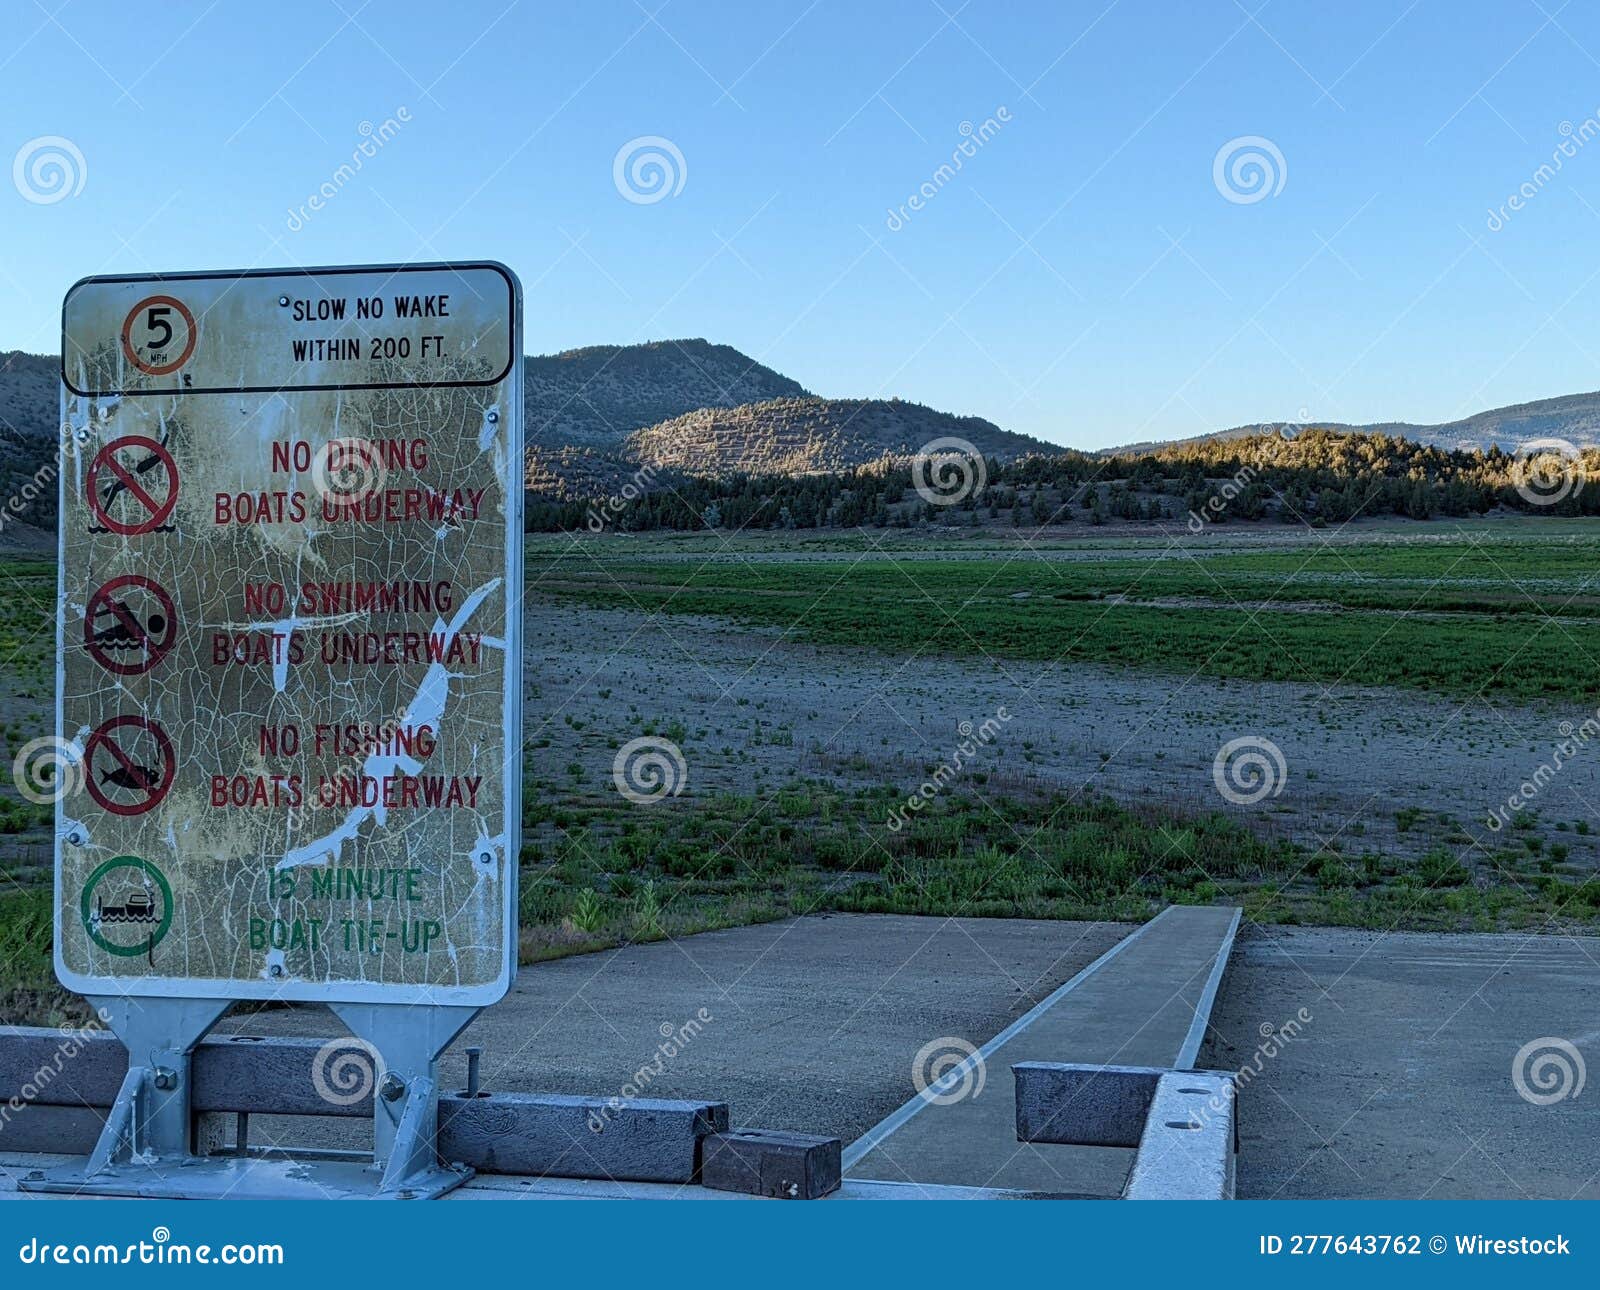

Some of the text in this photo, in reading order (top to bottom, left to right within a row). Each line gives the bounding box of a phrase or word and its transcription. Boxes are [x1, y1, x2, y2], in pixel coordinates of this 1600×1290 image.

[293, 295, 450, 322] SLOW NO WAKE
[147, 308, 173, 349] 5
[150, 353, 168, 363] MPH
[292, 335, 448, 362] WITHIN 200 FT.
[272, 438, 428, 473] NO DIVING
[214, 487, 485, 524] BOATS UNDERWAY
[244, 580, 452, 615] NO SWIMMING
[212, 631, 483, 665] BOATS UNDERWAY
[259, 724, 436, 757] NO FISHING
[211, 775, 483, 808] BOATS UNDERWAY
[267, 866, 423, 901] 15 MINUTE
[249, 917, 442, 952] BOAT TIE-UP
